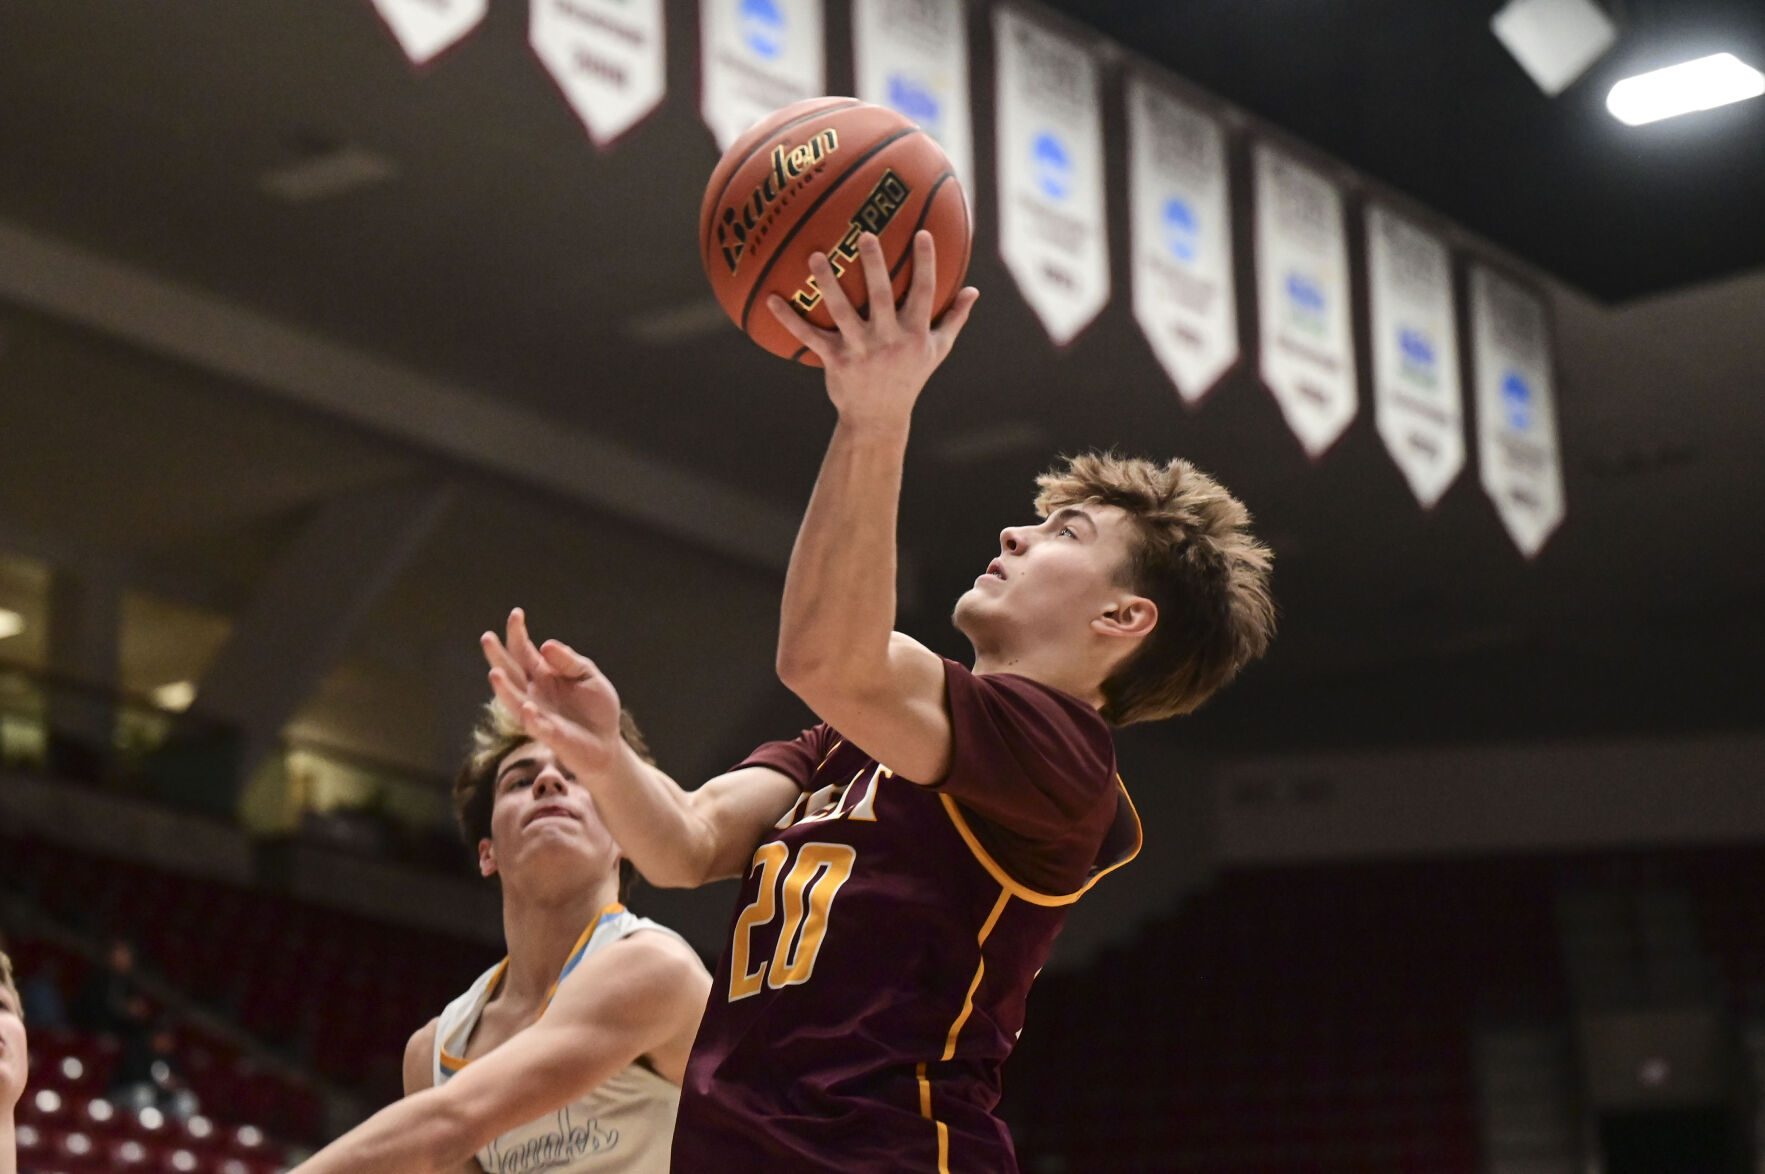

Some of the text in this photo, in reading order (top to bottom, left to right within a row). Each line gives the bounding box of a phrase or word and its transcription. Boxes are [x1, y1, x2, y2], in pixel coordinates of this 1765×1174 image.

[718, 127, 839, 276] Baden
[791, 177, 906, 317] LTE PRO
[728, 840, 857, 1002] 20
